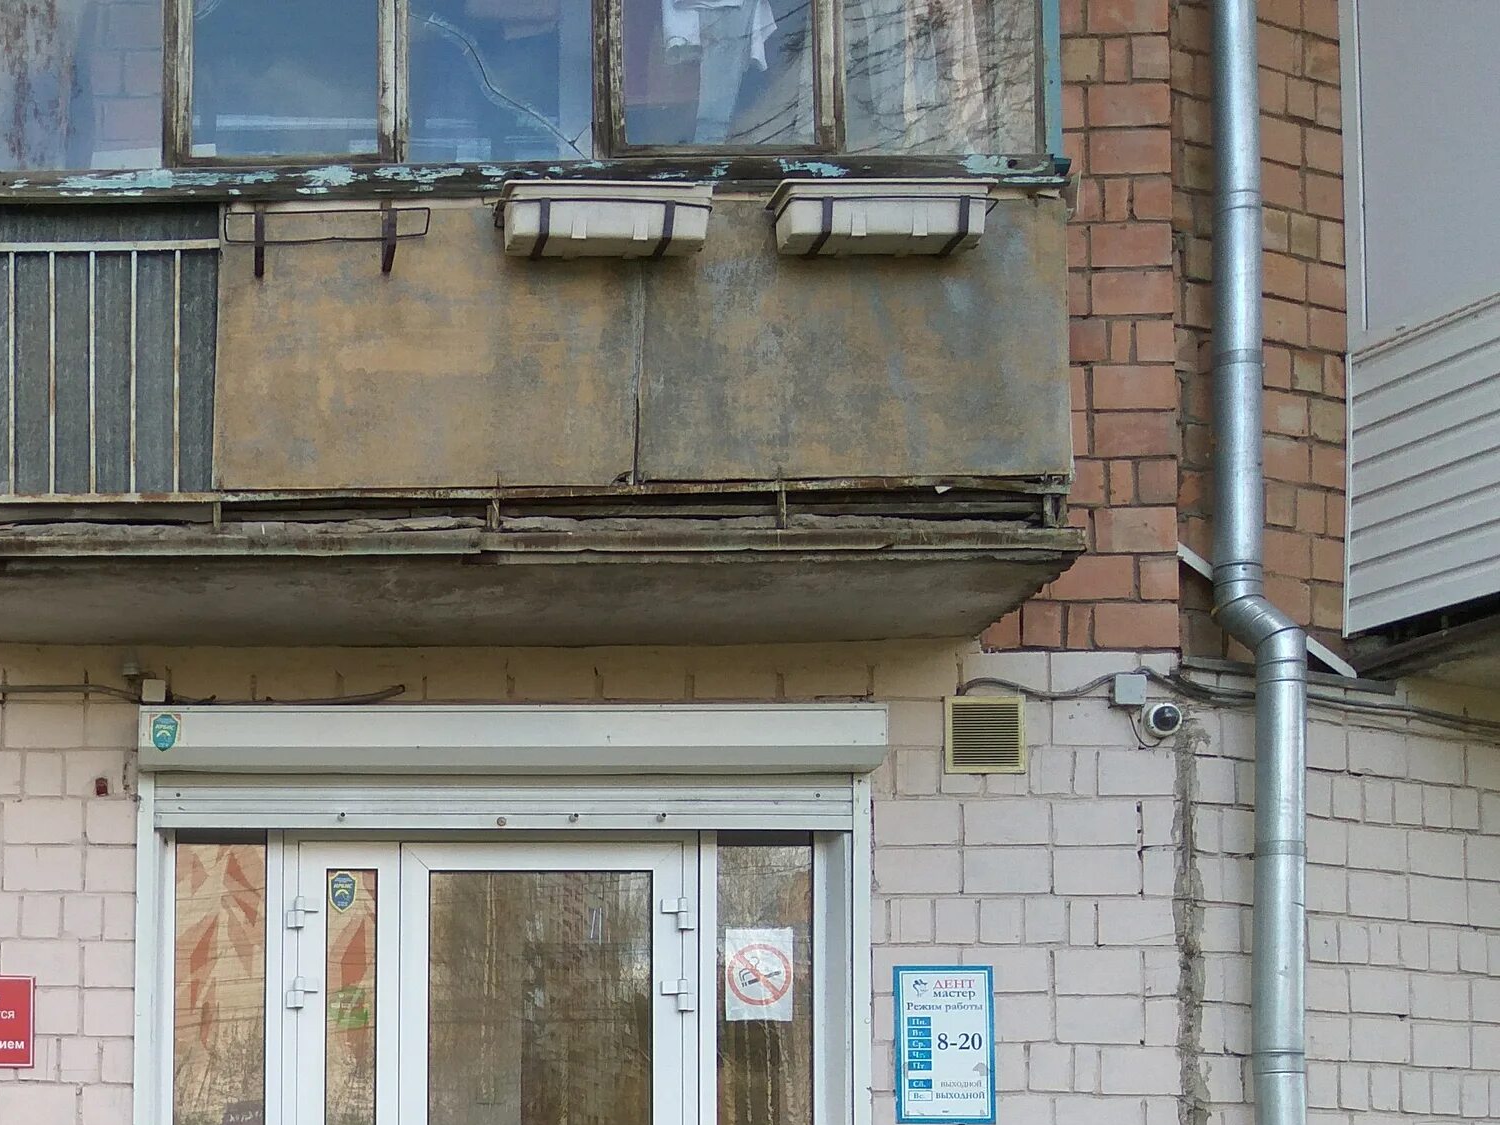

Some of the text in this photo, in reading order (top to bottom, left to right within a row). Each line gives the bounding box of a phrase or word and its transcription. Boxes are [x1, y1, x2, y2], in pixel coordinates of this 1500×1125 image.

[933, 979, 975, 990] ДЕНТ
[933, 990, 976, 1000] мастер
[906, 1002, 983, 1012] Режим работы
[937, 1033, 983, 1050] 8-20
